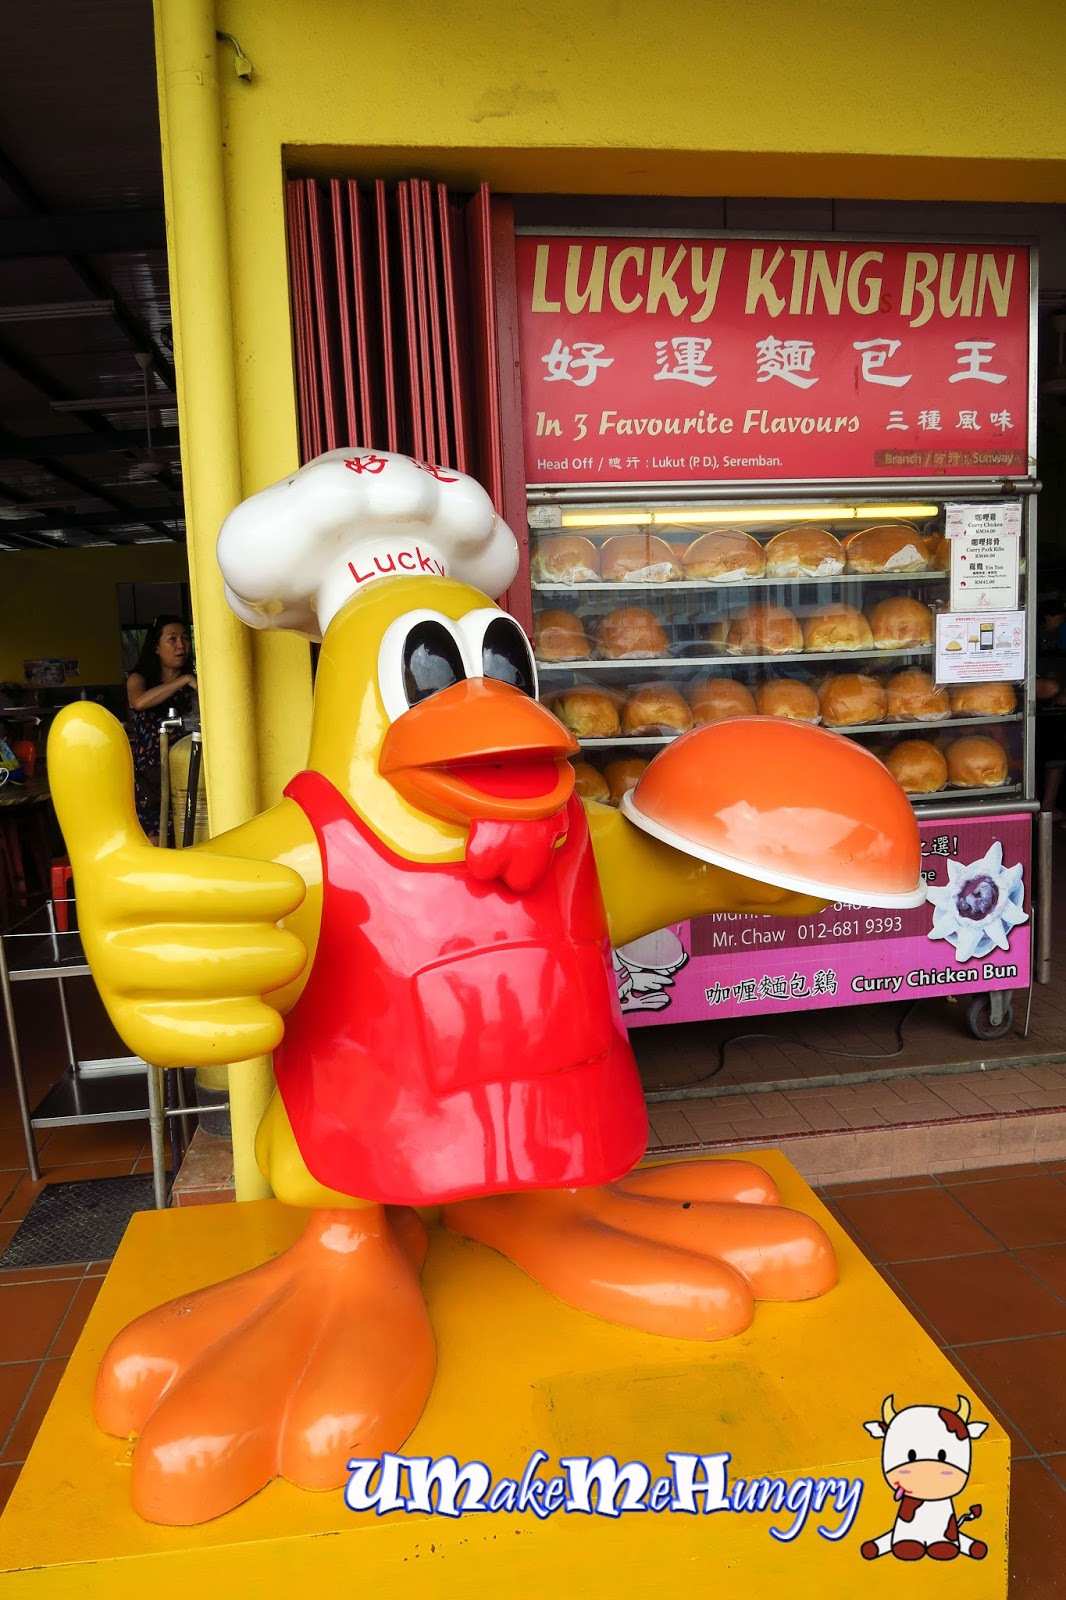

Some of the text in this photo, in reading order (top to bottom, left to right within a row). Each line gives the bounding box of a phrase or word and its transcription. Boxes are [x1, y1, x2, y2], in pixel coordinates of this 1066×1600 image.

[531, 243, 727, 323] LUCKY
[899, 252, 1016, 328] BUN
[535, 409, 860, 442] In 3 Favourite Flavours
[886, 409, 1014, 432] 三種風味
[537, 457, 569, 470] Head
[572, 456, 593, 469] Off
[652, 456, 685, 469] Lukut
[723, 454, 783, 468] Seremban.
[884, 453, 922, 465] Branch
[713, 916, 902, 948] Mr. Chaw 012-681 9393
[852, 964, 1018, 992] Curry Chicken Bun
